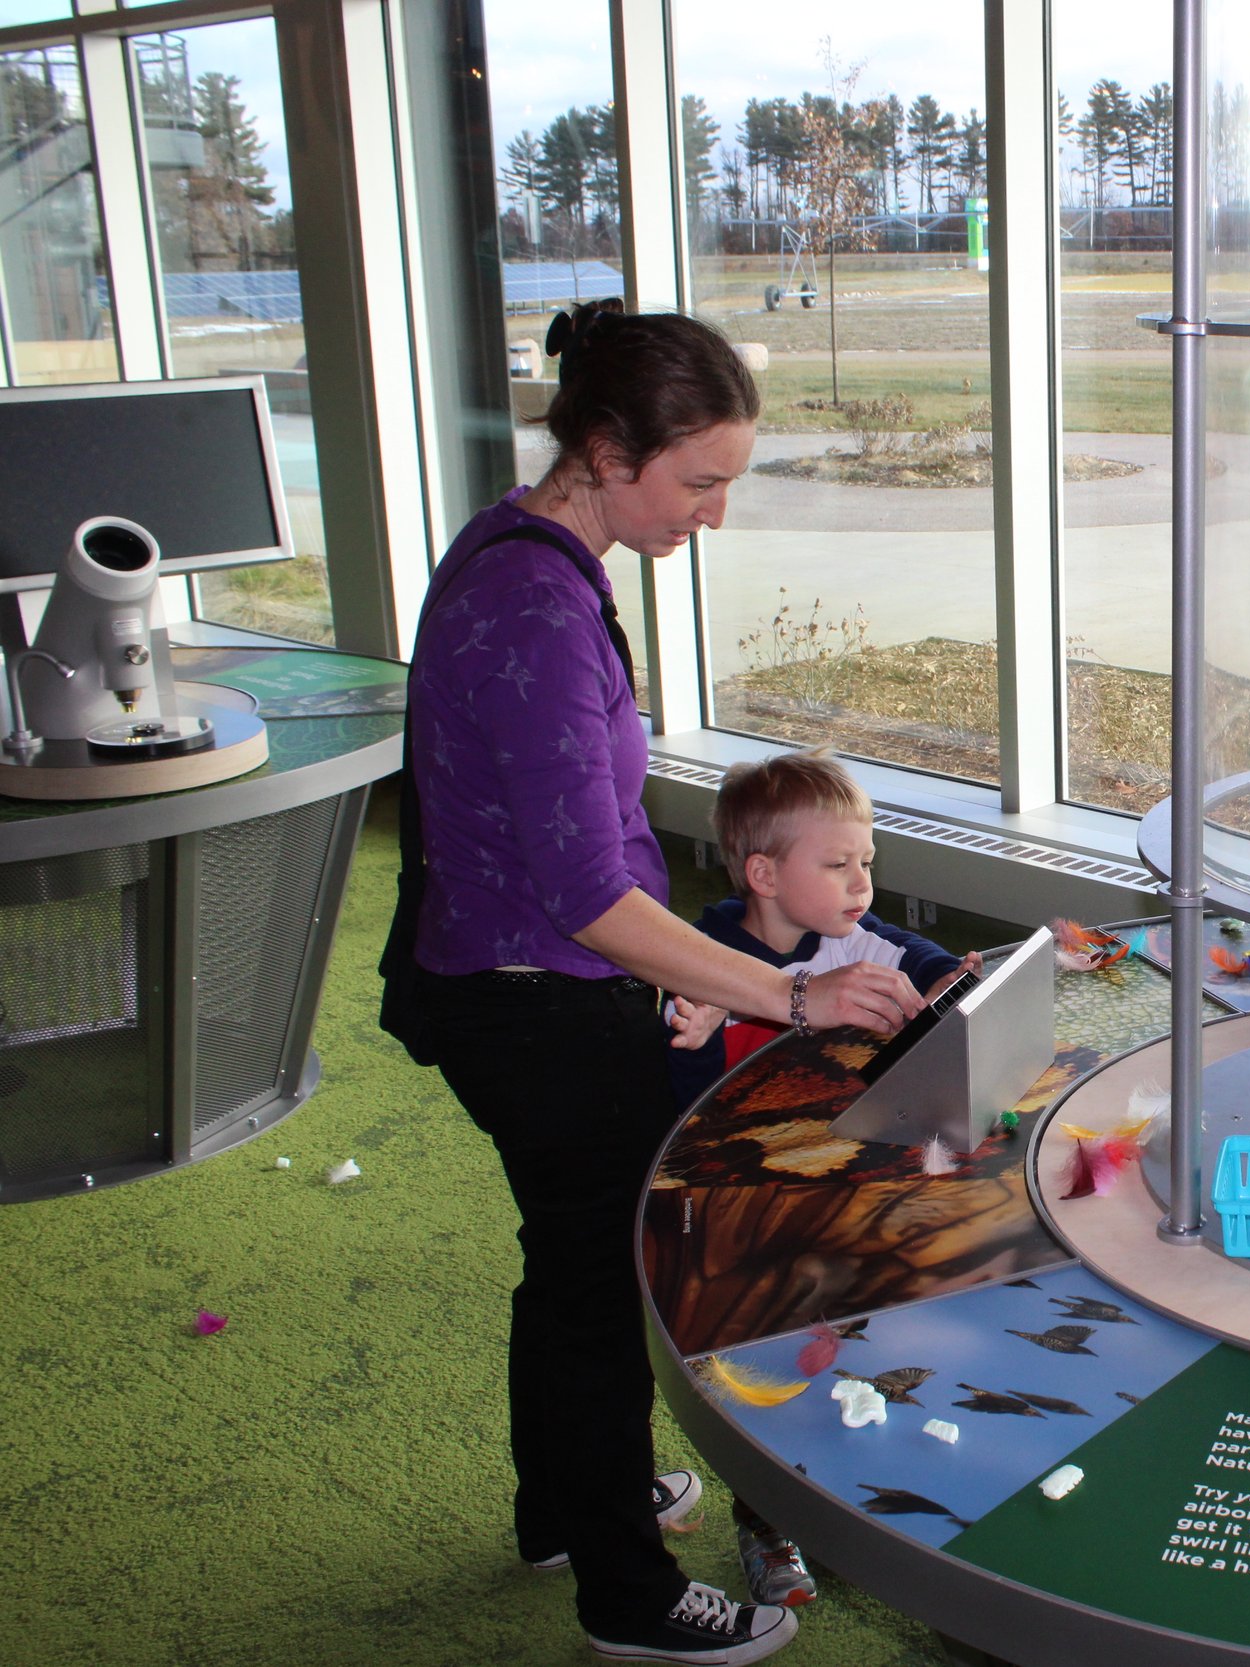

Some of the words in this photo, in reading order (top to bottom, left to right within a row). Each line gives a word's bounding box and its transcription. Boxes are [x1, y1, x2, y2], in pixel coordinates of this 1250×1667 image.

[1194, 1484, 1230, 1500] Try
[1176, 1518, 1219, 1532] get
[1224, 1522, 1243, 1536] it
[1169, 1534, 1227, 1552] swirl
[1161, 1548, 1205, 1567] like
[1209, 1559, 1227, 1570] a
